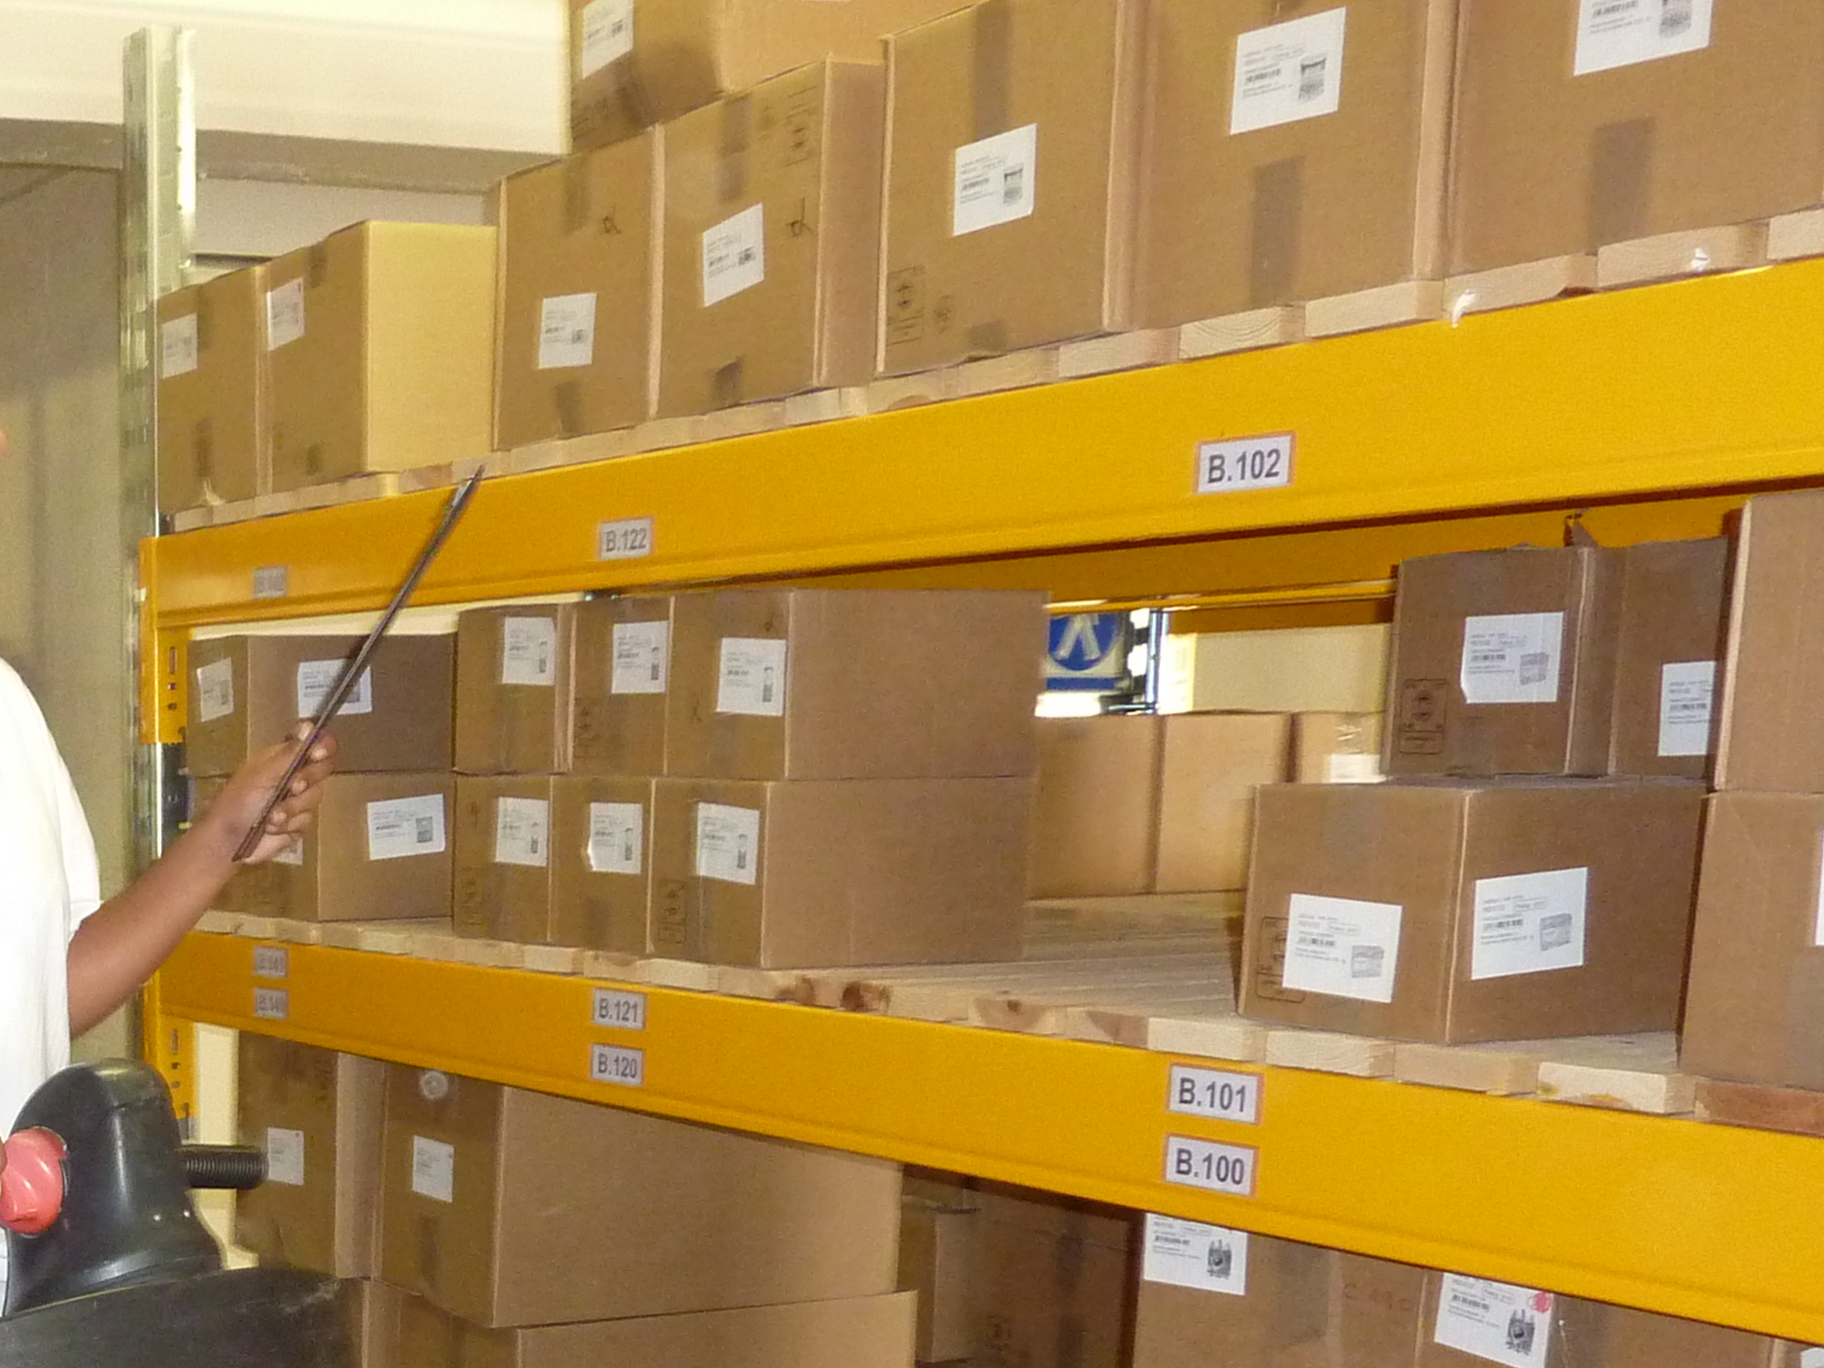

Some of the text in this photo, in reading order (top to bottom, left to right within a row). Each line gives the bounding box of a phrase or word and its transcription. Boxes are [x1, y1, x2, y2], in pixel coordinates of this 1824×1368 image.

[1207, 448, 1281, 484] B.102
[605, 528, 647, 552] B.122
[599, 997, 638, 1023] B.121
[598, 1052, 638, 1079] B.120
[1179, 1077, 1246, 1113] B.101
[1175, 1147, 1245, 1186] B.100
